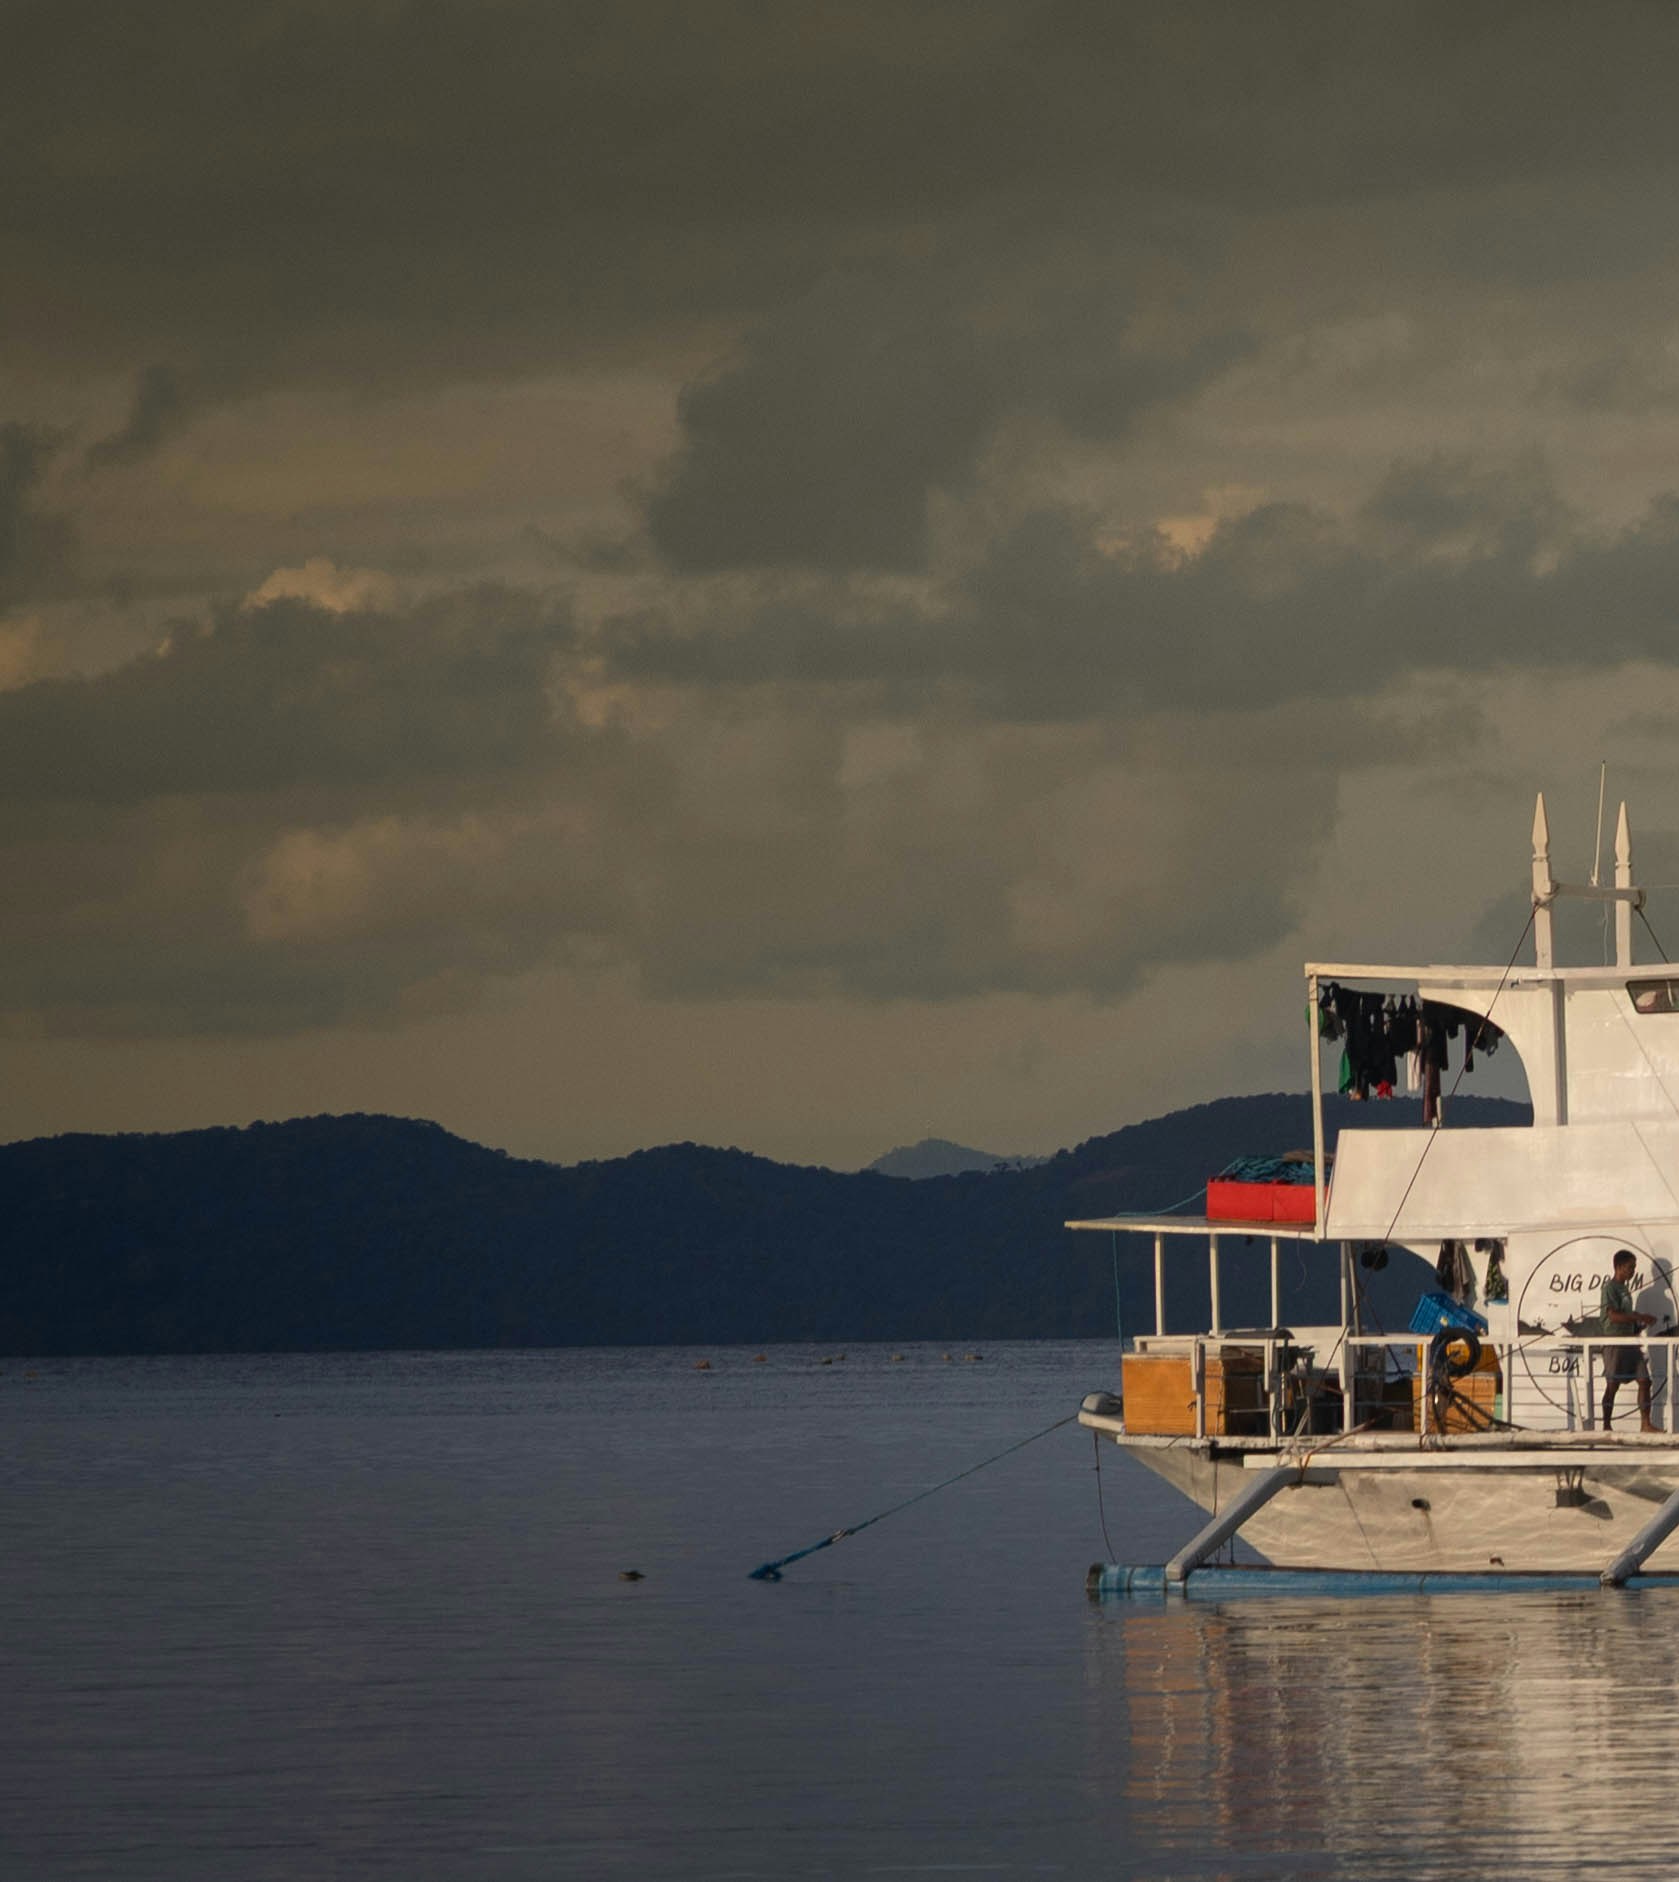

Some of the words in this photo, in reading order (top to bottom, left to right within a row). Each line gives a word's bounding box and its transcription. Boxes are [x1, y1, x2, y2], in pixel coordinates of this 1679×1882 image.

[1549, 1273, 1583, 1293] BIG
[1588, 1271, 1644, 1292] DRM
[1549, 1355, 1596, 1377] BOA
